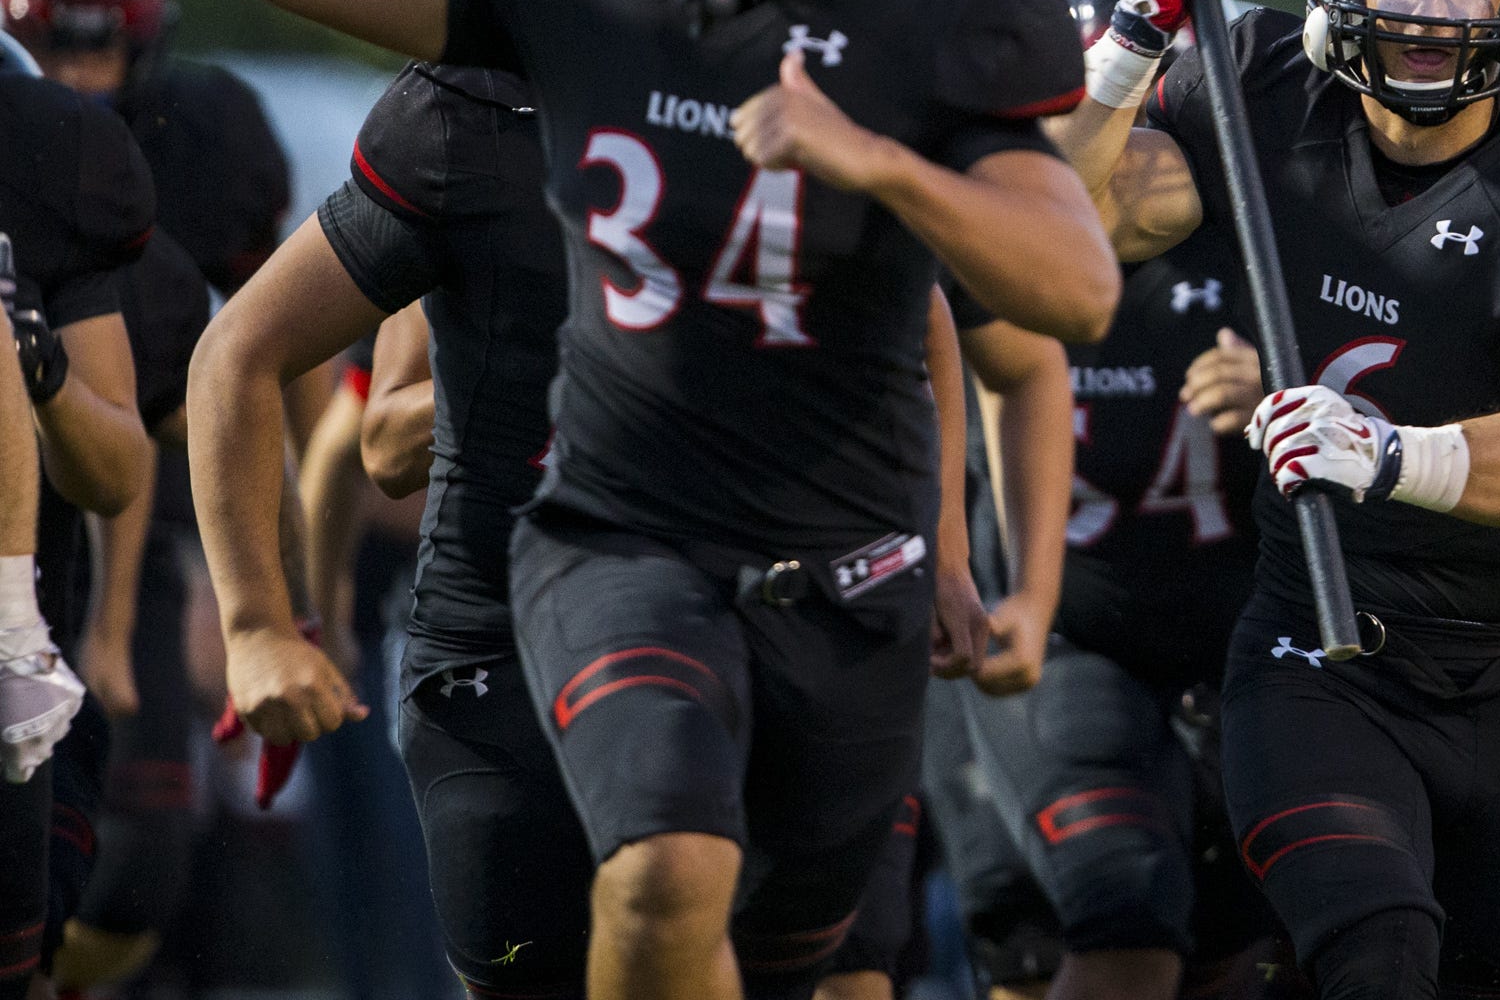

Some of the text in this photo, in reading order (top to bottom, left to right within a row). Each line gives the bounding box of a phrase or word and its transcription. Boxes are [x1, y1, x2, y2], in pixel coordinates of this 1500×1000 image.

[646, 90, 737, 140] LION
[577, 125, 818, 348] 34
[1319, 274, 1400, 325] LIONS
[1069, 366, 1157, 394] LIONS
